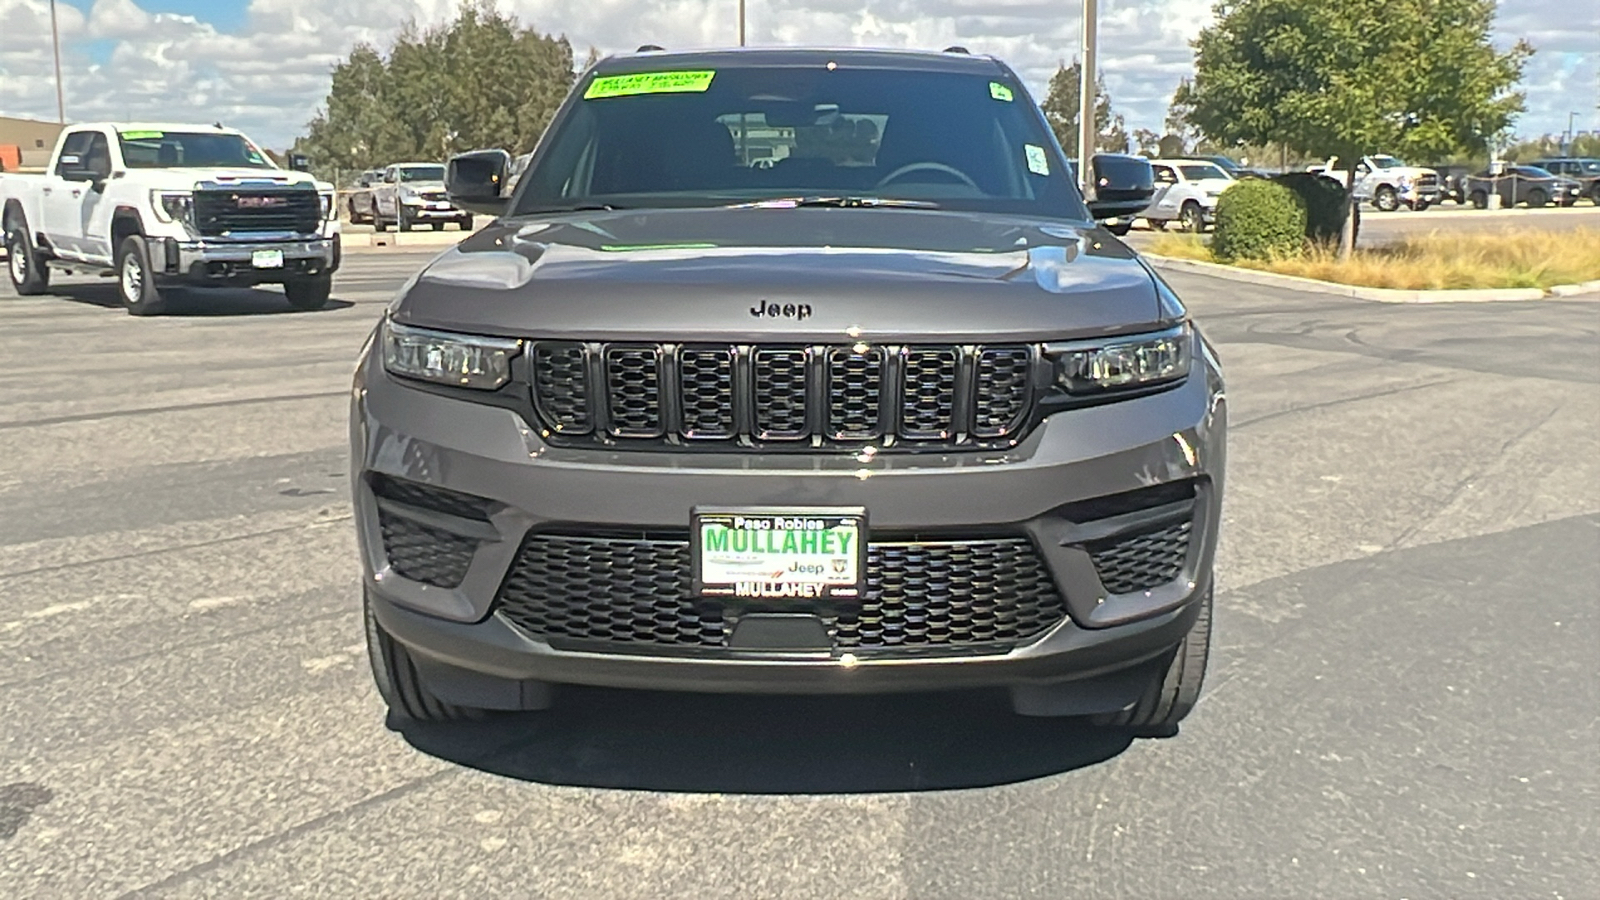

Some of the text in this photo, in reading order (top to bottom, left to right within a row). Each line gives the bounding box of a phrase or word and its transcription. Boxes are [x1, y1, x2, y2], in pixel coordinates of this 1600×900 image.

[750, 300, 812, 321] Jeep
[734, 517, 771, 530] Paso
[774, 517, 825, 531] Robles
[706, 527, 853, 555] MULLAHEY
[788, 561, 825, 576] Jeep
[735, 582, 826, 598] MULLAHEY
